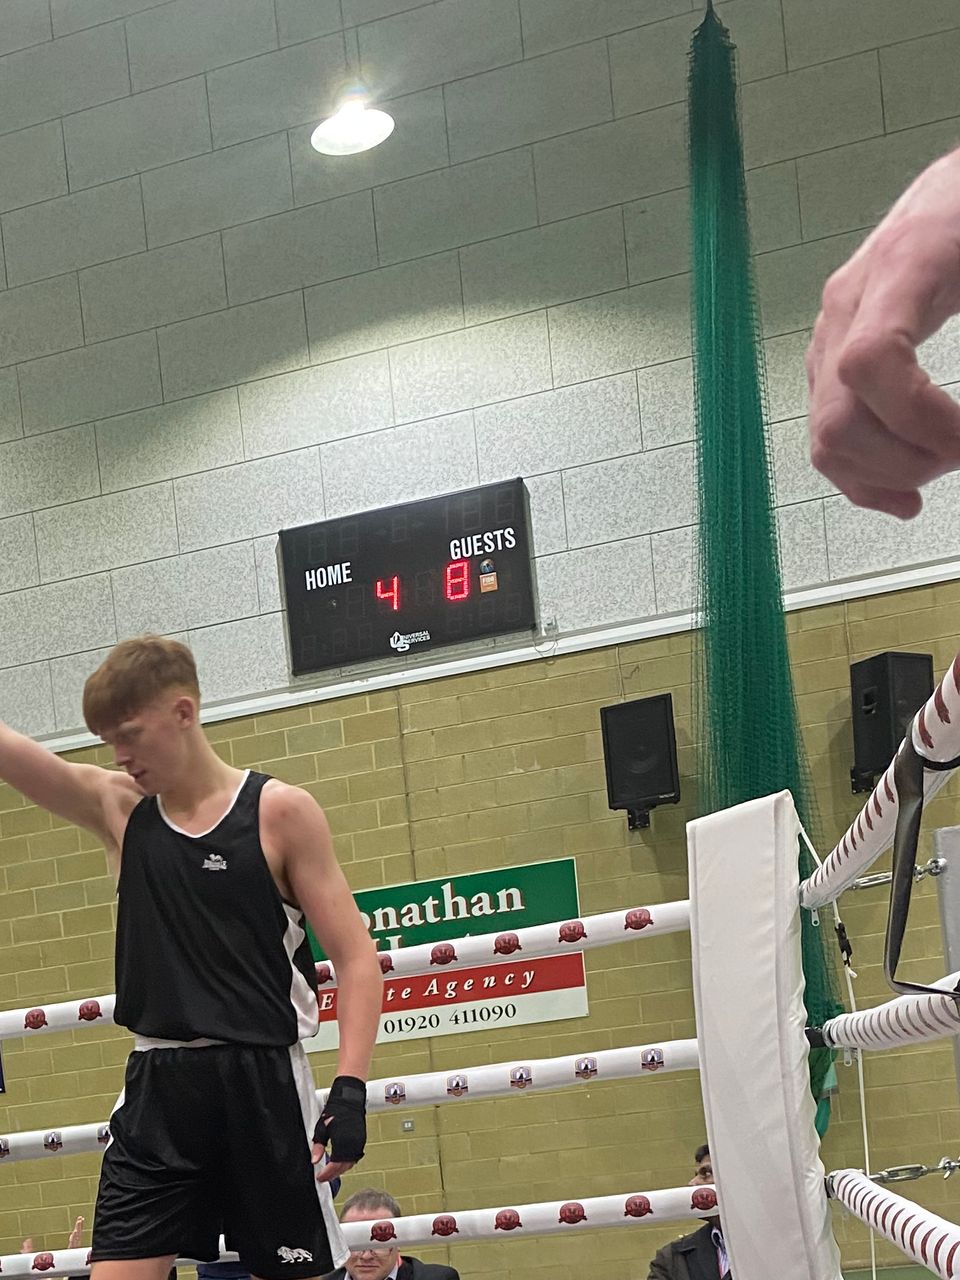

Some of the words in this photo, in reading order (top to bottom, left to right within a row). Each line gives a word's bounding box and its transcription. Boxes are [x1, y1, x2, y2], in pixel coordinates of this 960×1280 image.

[450, 527, 516, 560] GUESTS
[305, 562, 352, 590] HOME
[376, 576, 400, 610] 4
[446, 560, 470, 601] 8
[359, 881, 525, 932] nathan
[320, 986, 412, 1011] Ete
[424, 969, 535, 999] Agency
[384, 1013, 440, 1035] 01920
[449, 1003, 517, 1026] 411090
